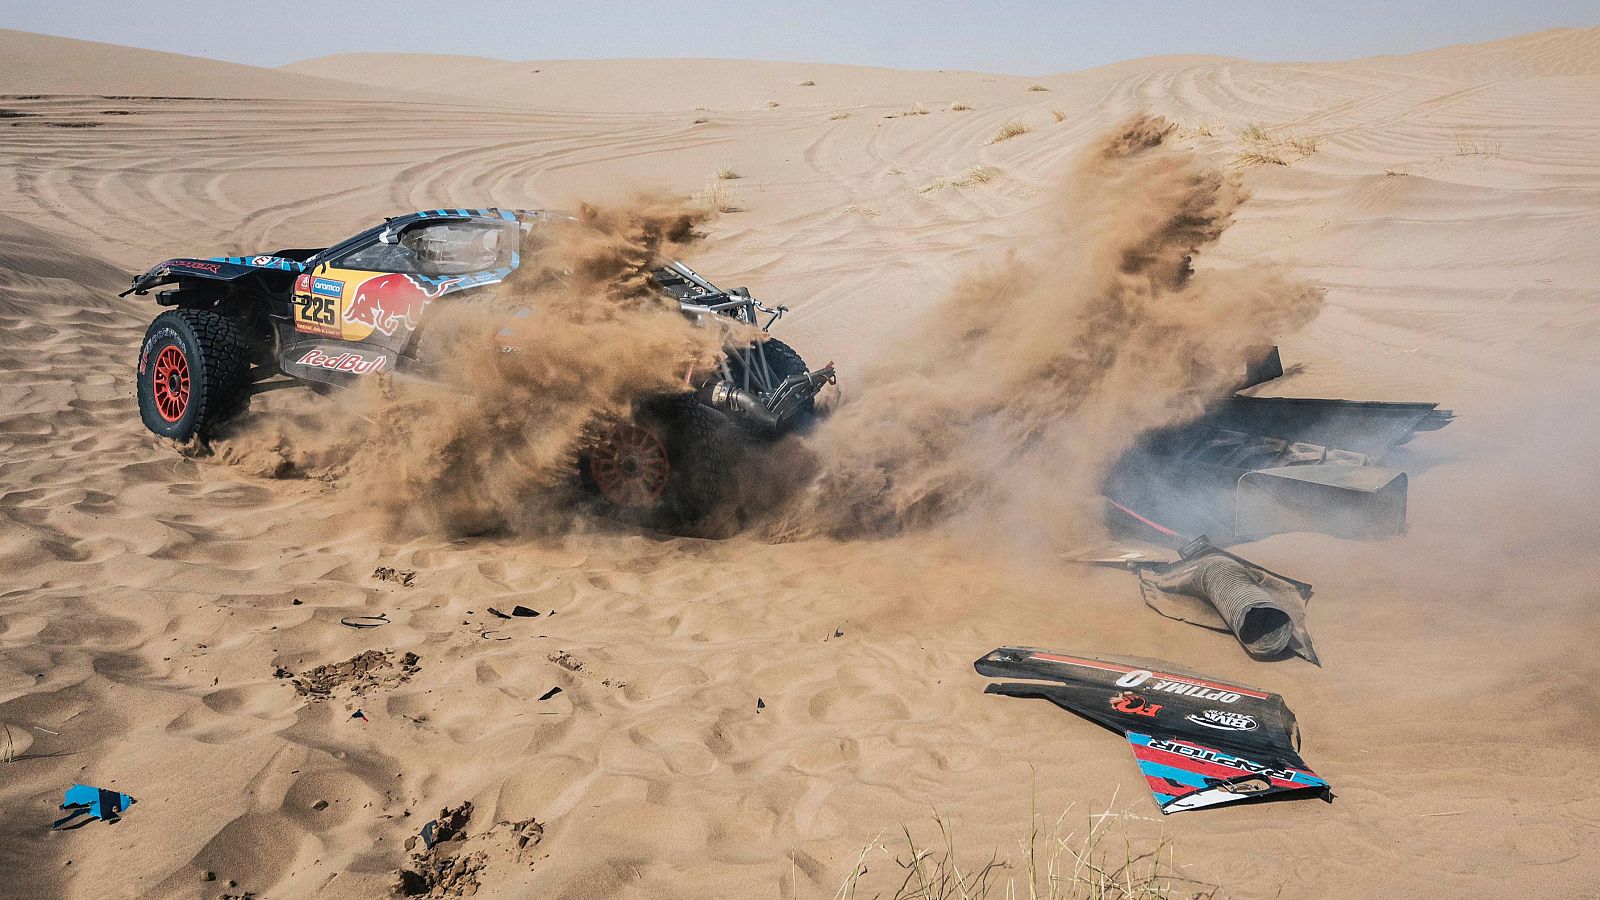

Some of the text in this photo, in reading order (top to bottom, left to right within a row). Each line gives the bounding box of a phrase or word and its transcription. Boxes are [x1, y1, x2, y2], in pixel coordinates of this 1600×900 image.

[315, 282, 341, 293] aramco
[301, 295, 335, 325] 225
[1109, 691, 1164, 718] FO
[1152, 680, 1242, 703] OPTIMA
[1147, 737, 1297, 781] RAPTOR
